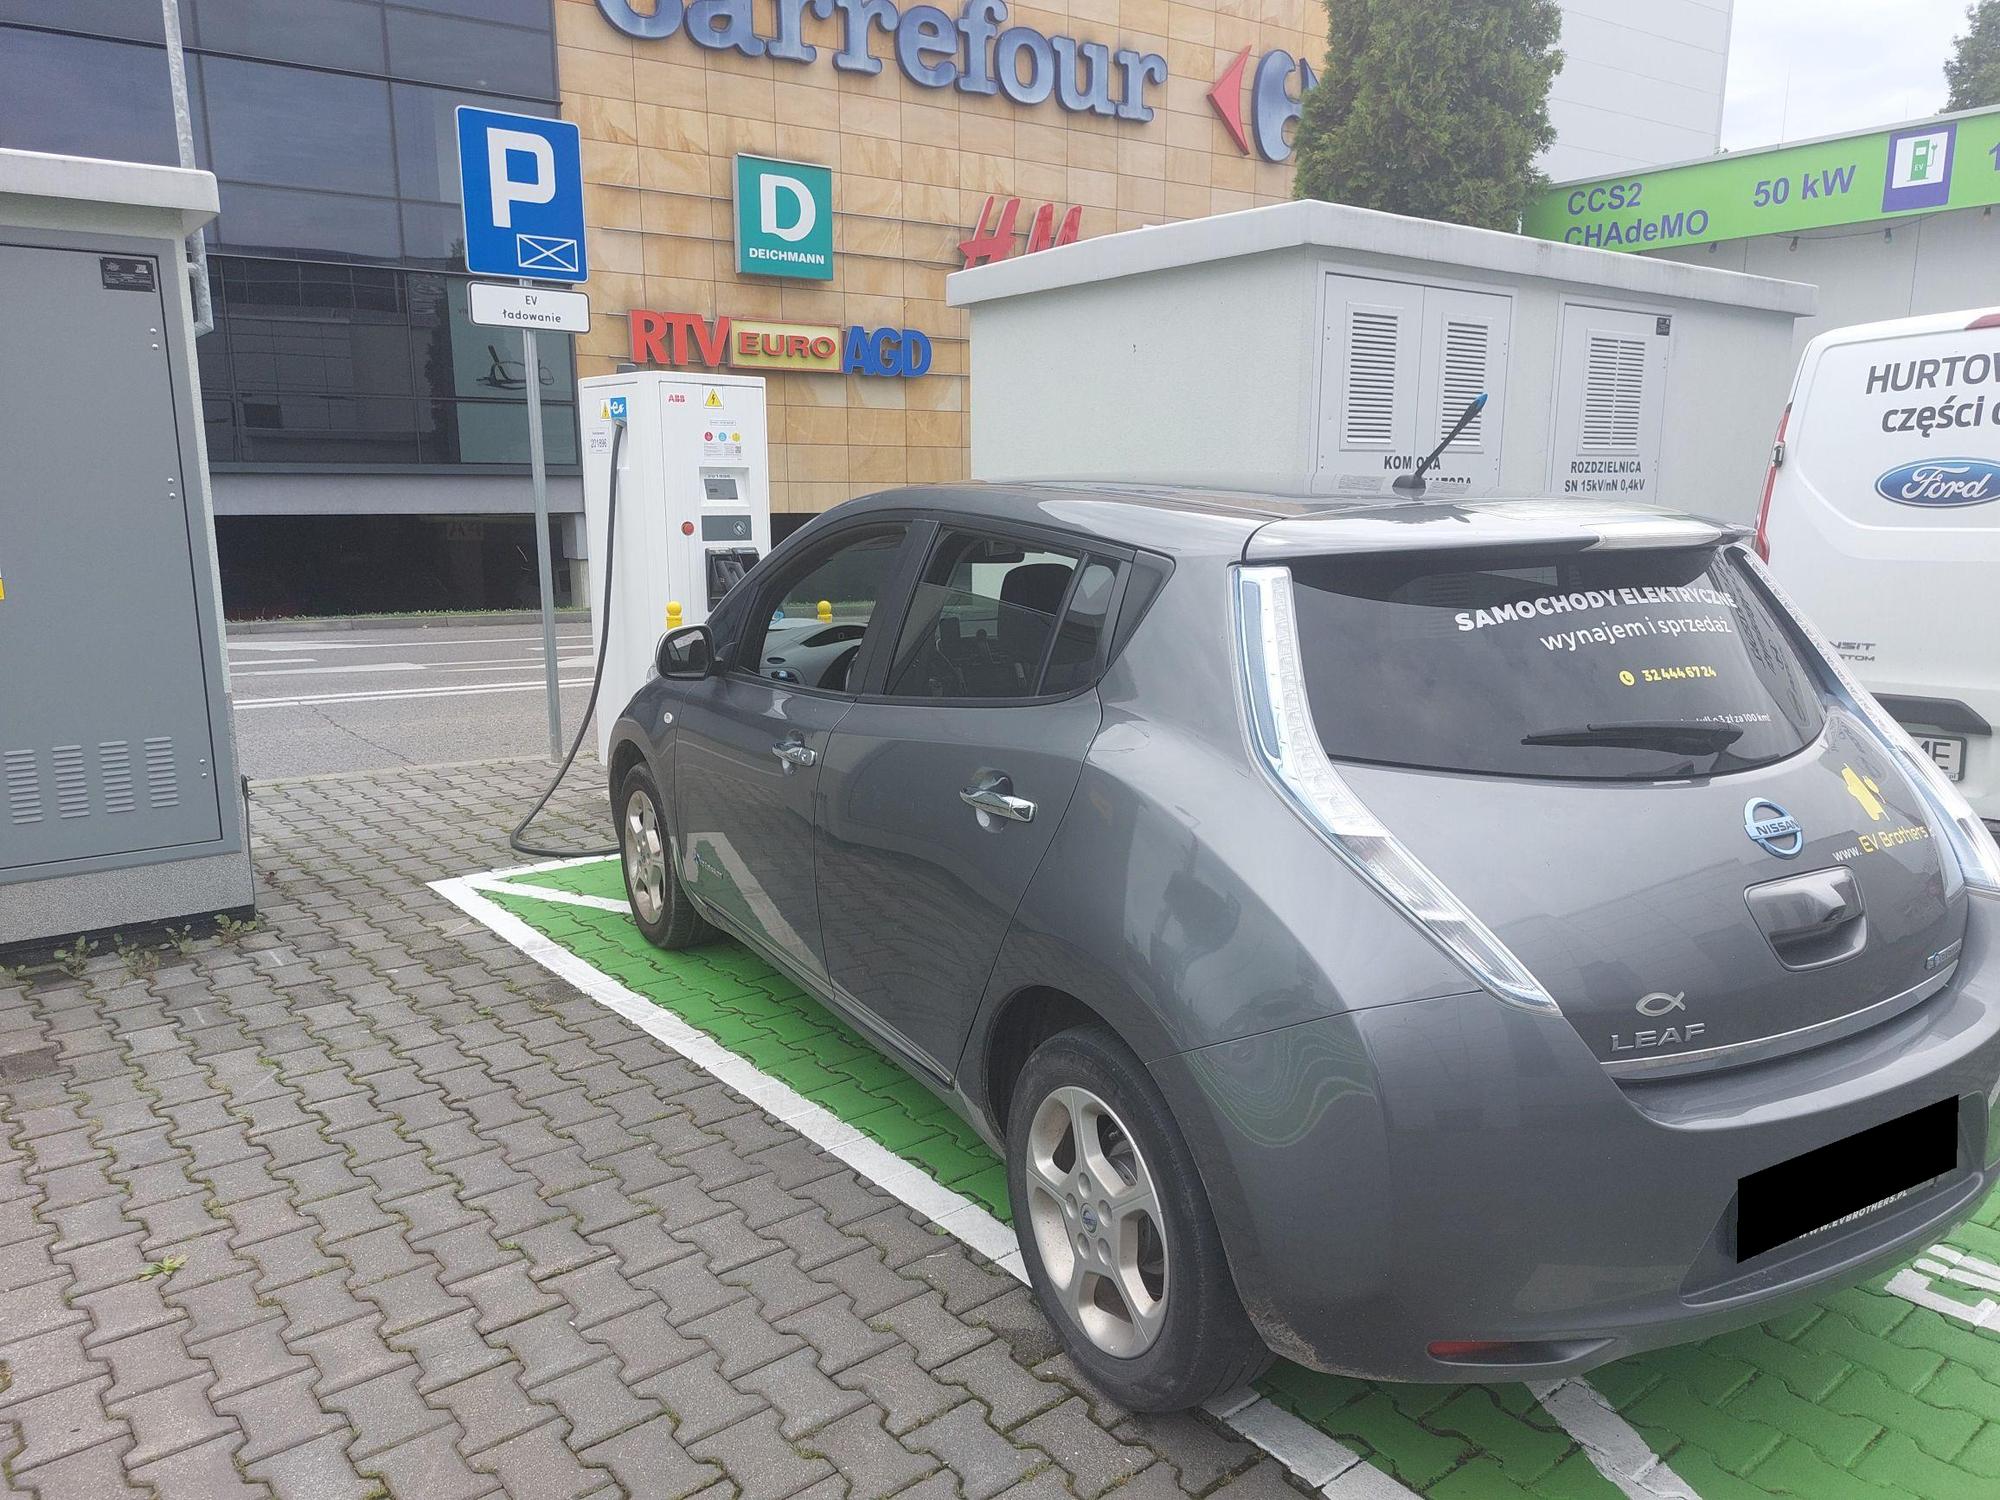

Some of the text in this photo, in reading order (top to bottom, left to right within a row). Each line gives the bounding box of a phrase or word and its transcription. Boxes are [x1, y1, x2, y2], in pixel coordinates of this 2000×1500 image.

[487, 127, 556, 228] P
[1753, 165, 1856, 207] 50 kW
[759, 173, 816, 242] D
[1567, 182, 1643, 215] CCS2
[1564, 209, 1709, 247] CHAdeMO
[749, 247, 825, 265] DEICHMANN
[502, 309, 562, 324] ładowanie
[525, 295, 538, 306] EV
[629, 310, 933, 377] RTV EURO AGD
[1865, 352, 2000, 395] HURTO
[668, 394, 685, 403] ABB
[1882, 395, 1985, 438] części
[1571, 461, 1642, 474] ROZDZIELNICA
[1901, 466, 1992, 499] Ford
[1564, 479, 1578, 492] SN
[1620, 478, 1645, 493] 0,4kV
[1455, 586, 1738, 631] SAMOCHODY ELEKTRYCZNE
[1540, 615, 1733, 651] wynajem i sprzedaż
[1756, 820, 1799, 835] NISSAN
[1611, 1022, 1705, 1052] LEAF
